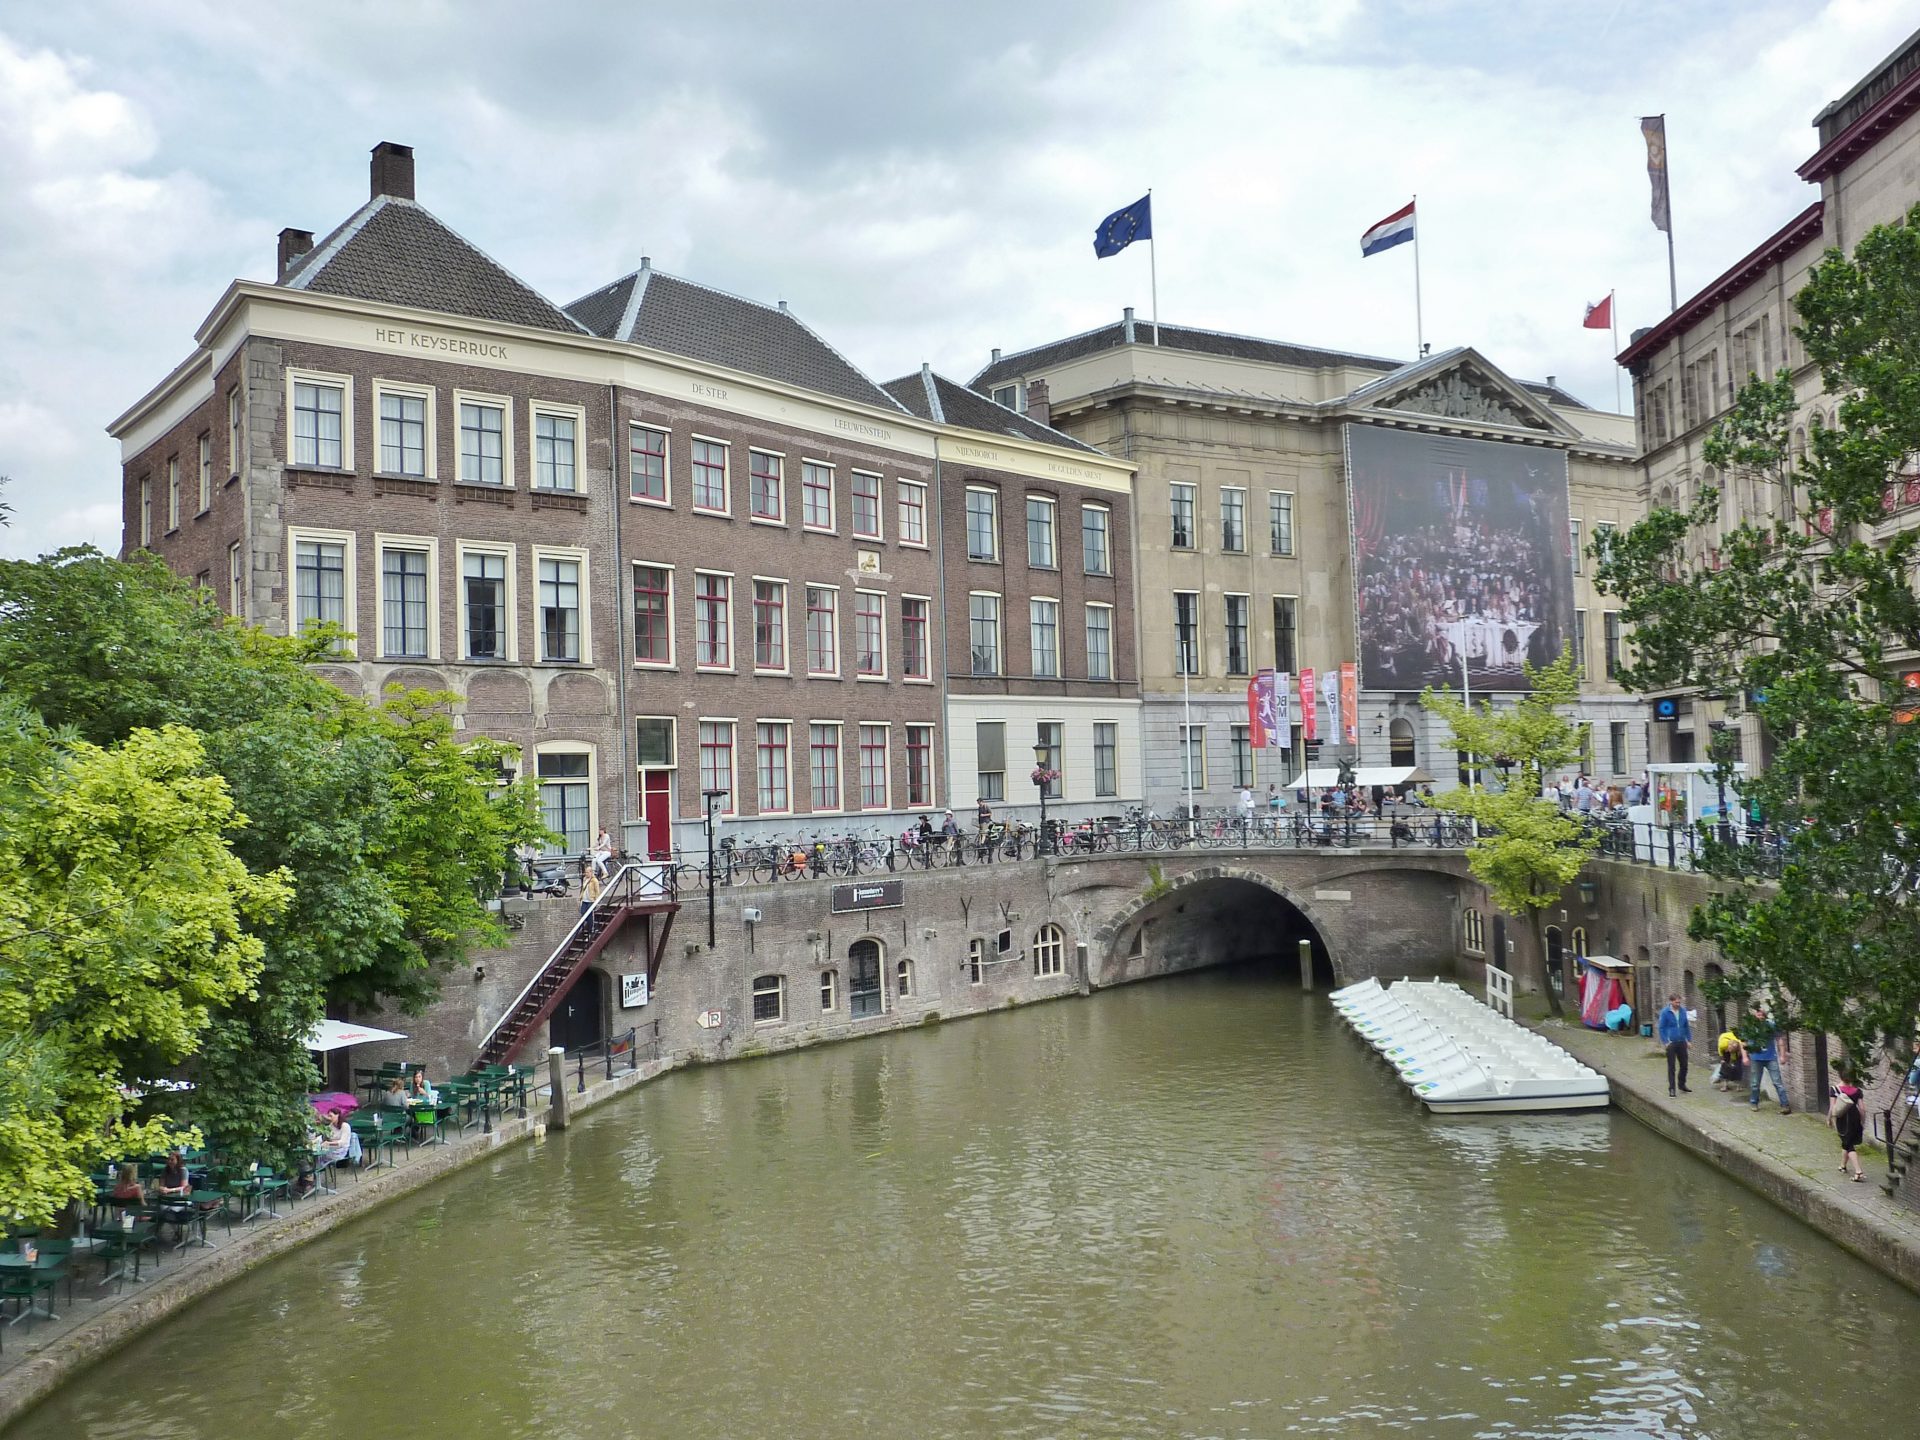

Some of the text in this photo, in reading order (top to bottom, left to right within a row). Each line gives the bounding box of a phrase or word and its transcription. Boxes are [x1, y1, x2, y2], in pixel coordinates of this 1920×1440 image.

[376, 328, 508, 359] HET KEYSERRUCK
[691, 383, 729, 401] DE STER
